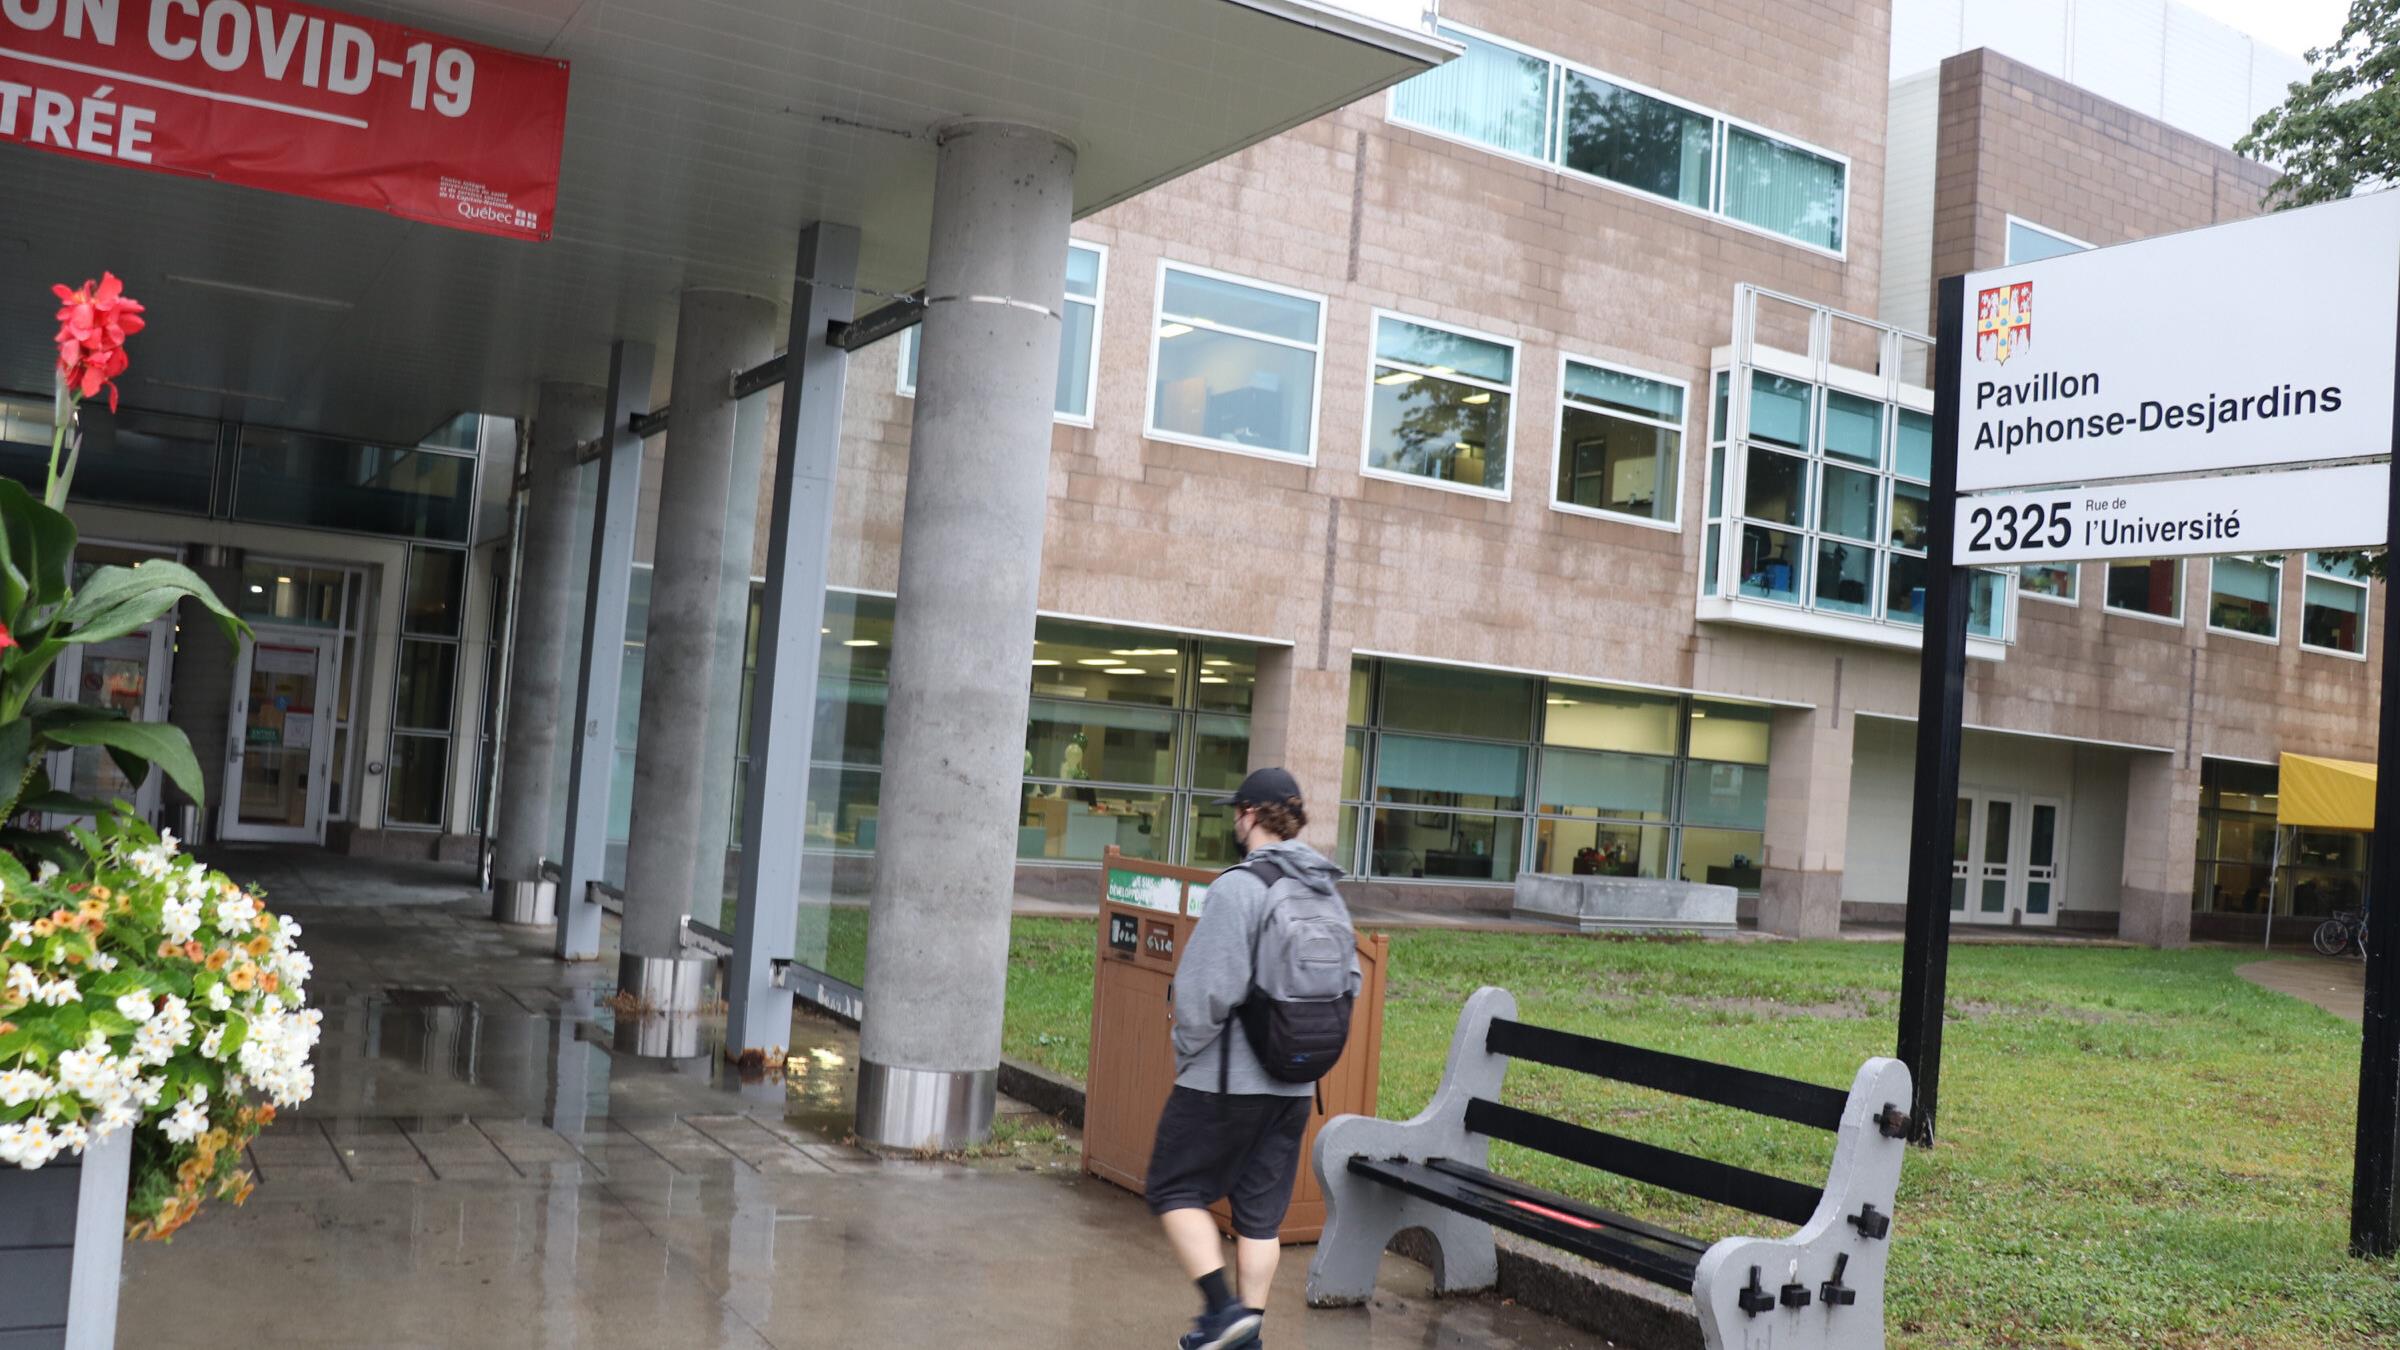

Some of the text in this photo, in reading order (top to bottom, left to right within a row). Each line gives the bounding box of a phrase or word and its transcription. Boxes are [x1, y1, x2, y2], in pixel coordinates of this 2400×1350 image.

[147, 0, 475, 118] COVID-19
[0, 81, 157, 164] TRÉE
[458, 202, 512, 224] Québec
[1976, 371, 2100, 410] Pavillon
[1973, 383, 2342, 455] Alphonse-Desjardins
[1968, 501, 2072, 553] 2325
[2085, 497, 2127, 511] Rue de
